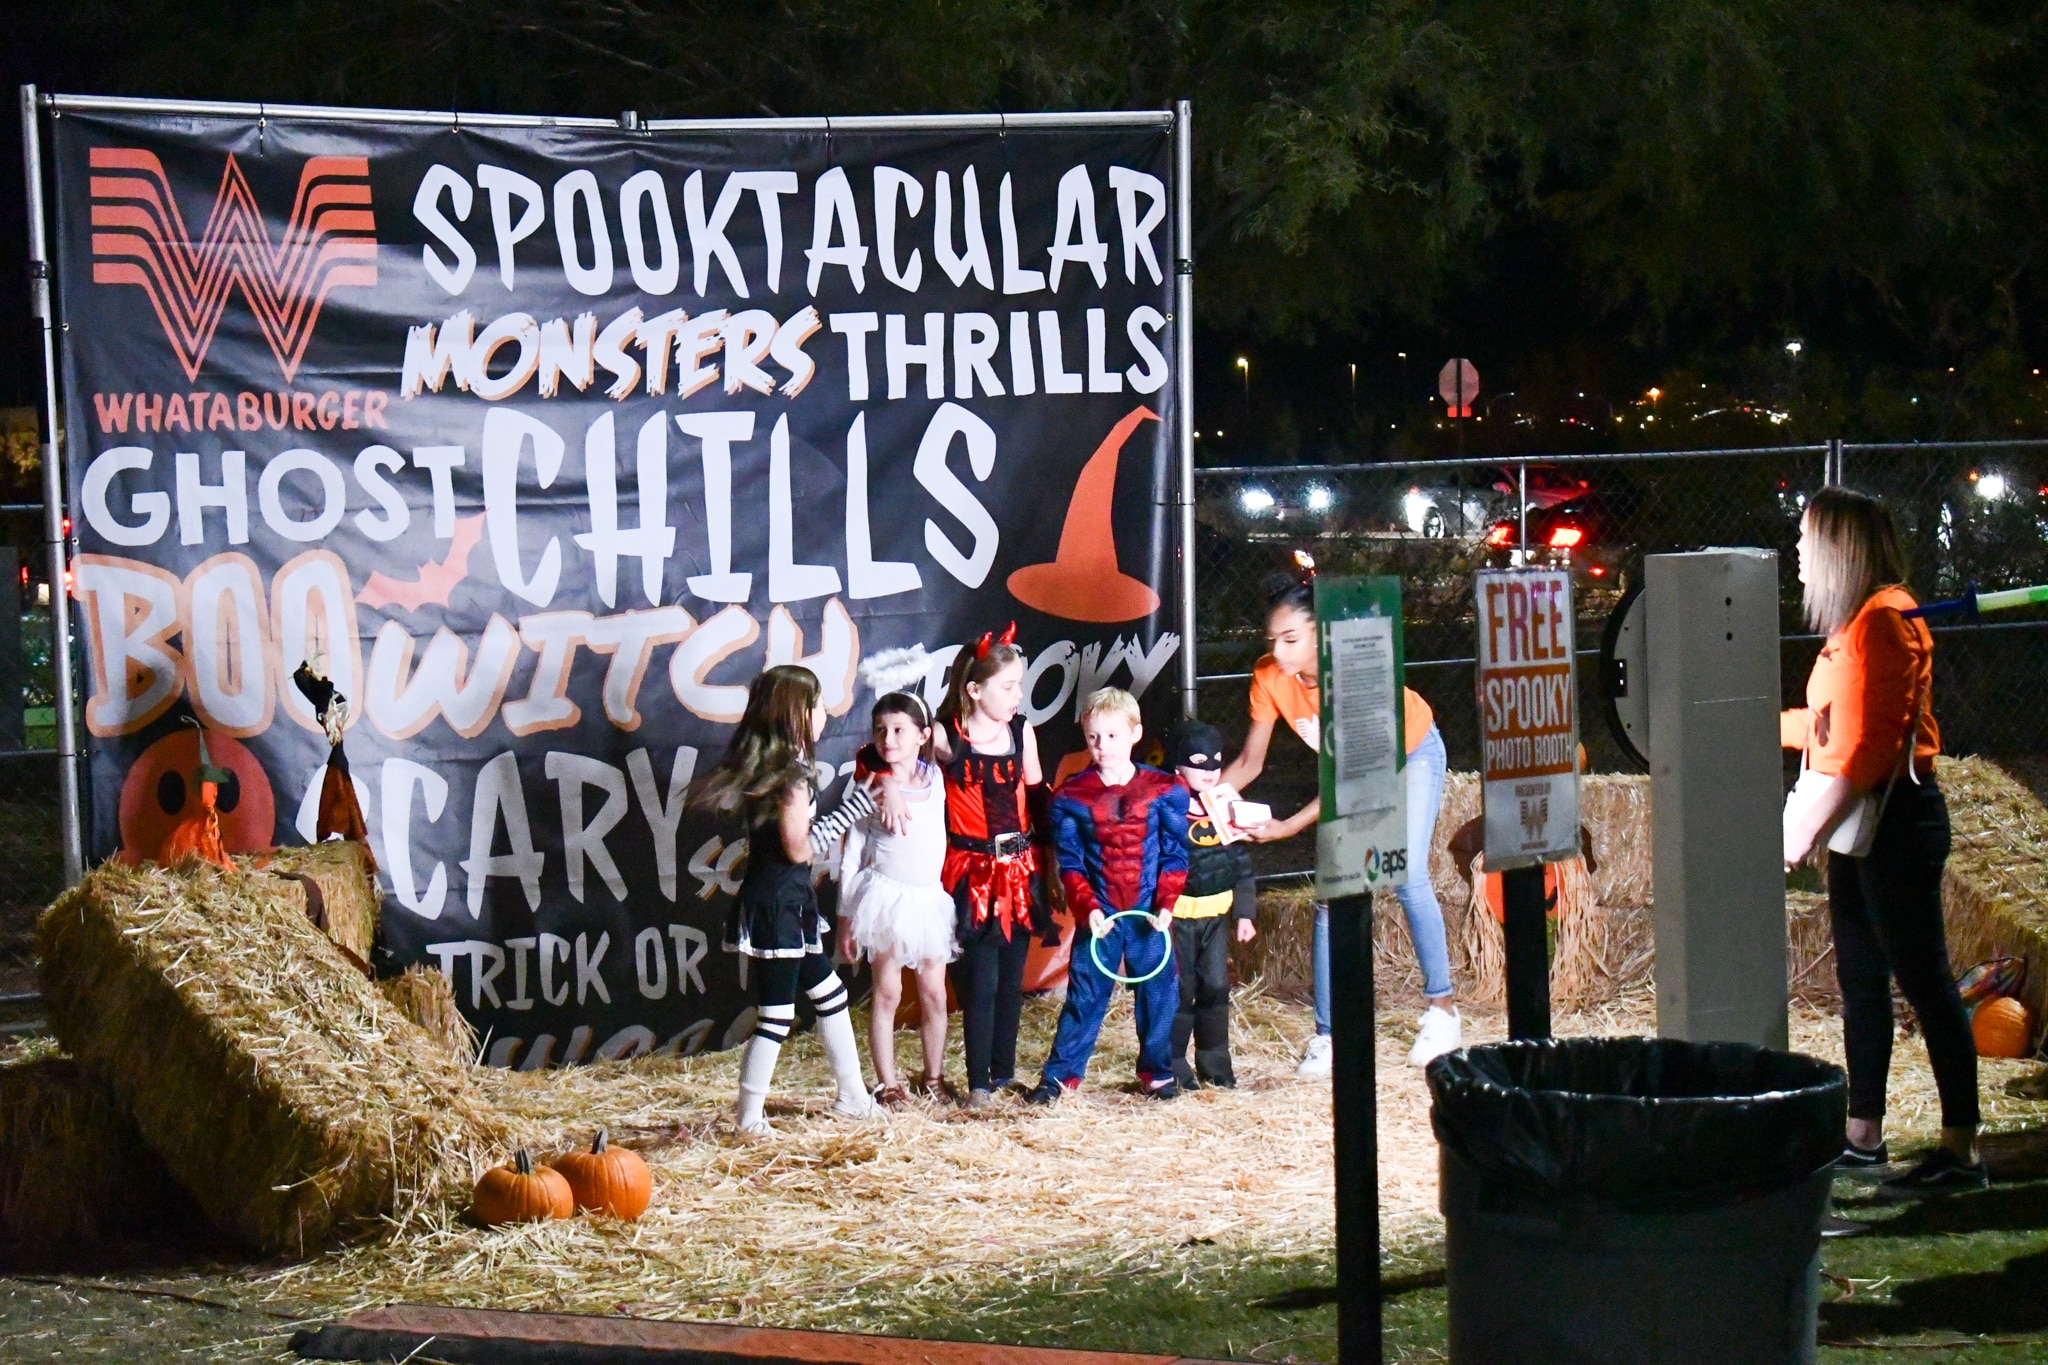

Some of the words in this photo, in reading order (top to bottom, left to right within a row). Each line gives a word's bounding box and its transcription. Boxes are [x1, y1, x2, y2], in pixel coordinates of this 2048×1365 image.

[413, 163, 1166, 298] SPOOKTACULAR
[401, 305, 821, 402] MONSTERS
[829, 305, 1169, 401] THRILLS
[93, 390, 389, 432] WHATABURGER
[81, 445, 466, 546] GHOST
[483, 402, 1000, 608] CHILLS
[72, 549, 362, 738] BOO
[365, 597, 860, 738] WITCH
[1486, 580, 1566, 663] FREE
[1486, 673, 1570, 733] SPOOKY
[1486, 735, 1531, 771] PHOTO
[1534, 731, 1573, 766] BOOTH
[1381, 847, 1407, 879] aps
[426, 930, 611, 1011] TRICK
[635, 923, 709, 1000] OR
